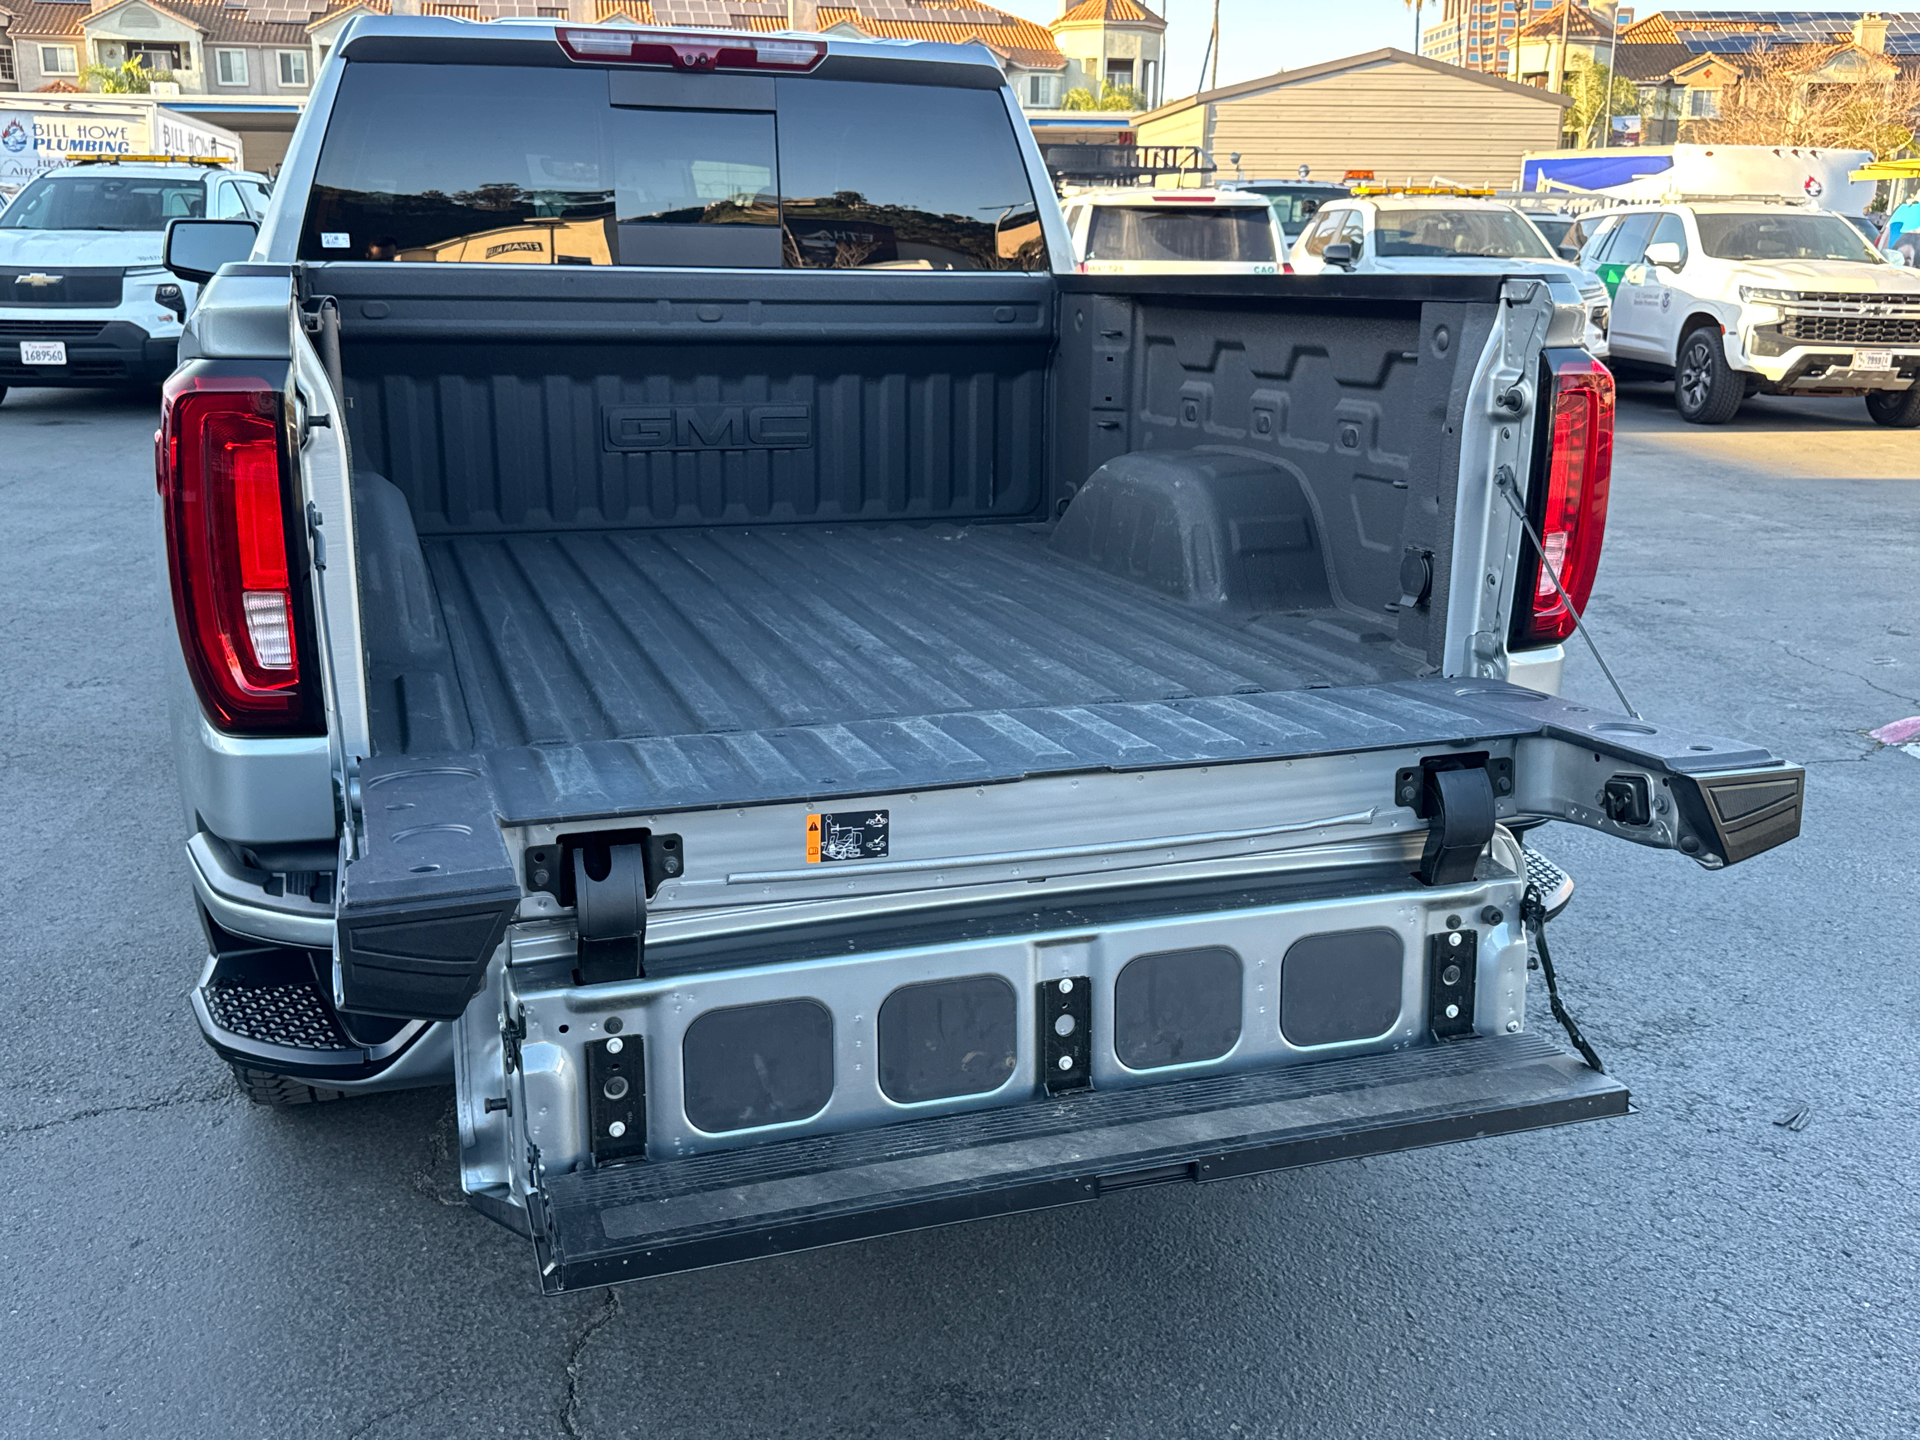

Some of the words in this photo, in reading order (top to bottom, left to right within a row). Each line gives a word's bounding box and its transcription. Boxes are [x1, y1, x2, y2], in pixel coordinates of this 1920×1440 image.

[32, 123, 69, 138] BILL
[77, 125, 129, 140] HOWE
[163, 124, 185, 153] BILL
[32, 138, 129, 153] PLUMBING
[25, 350, 63, 361] 1689560
[609, 407, 808, 447] GMC
